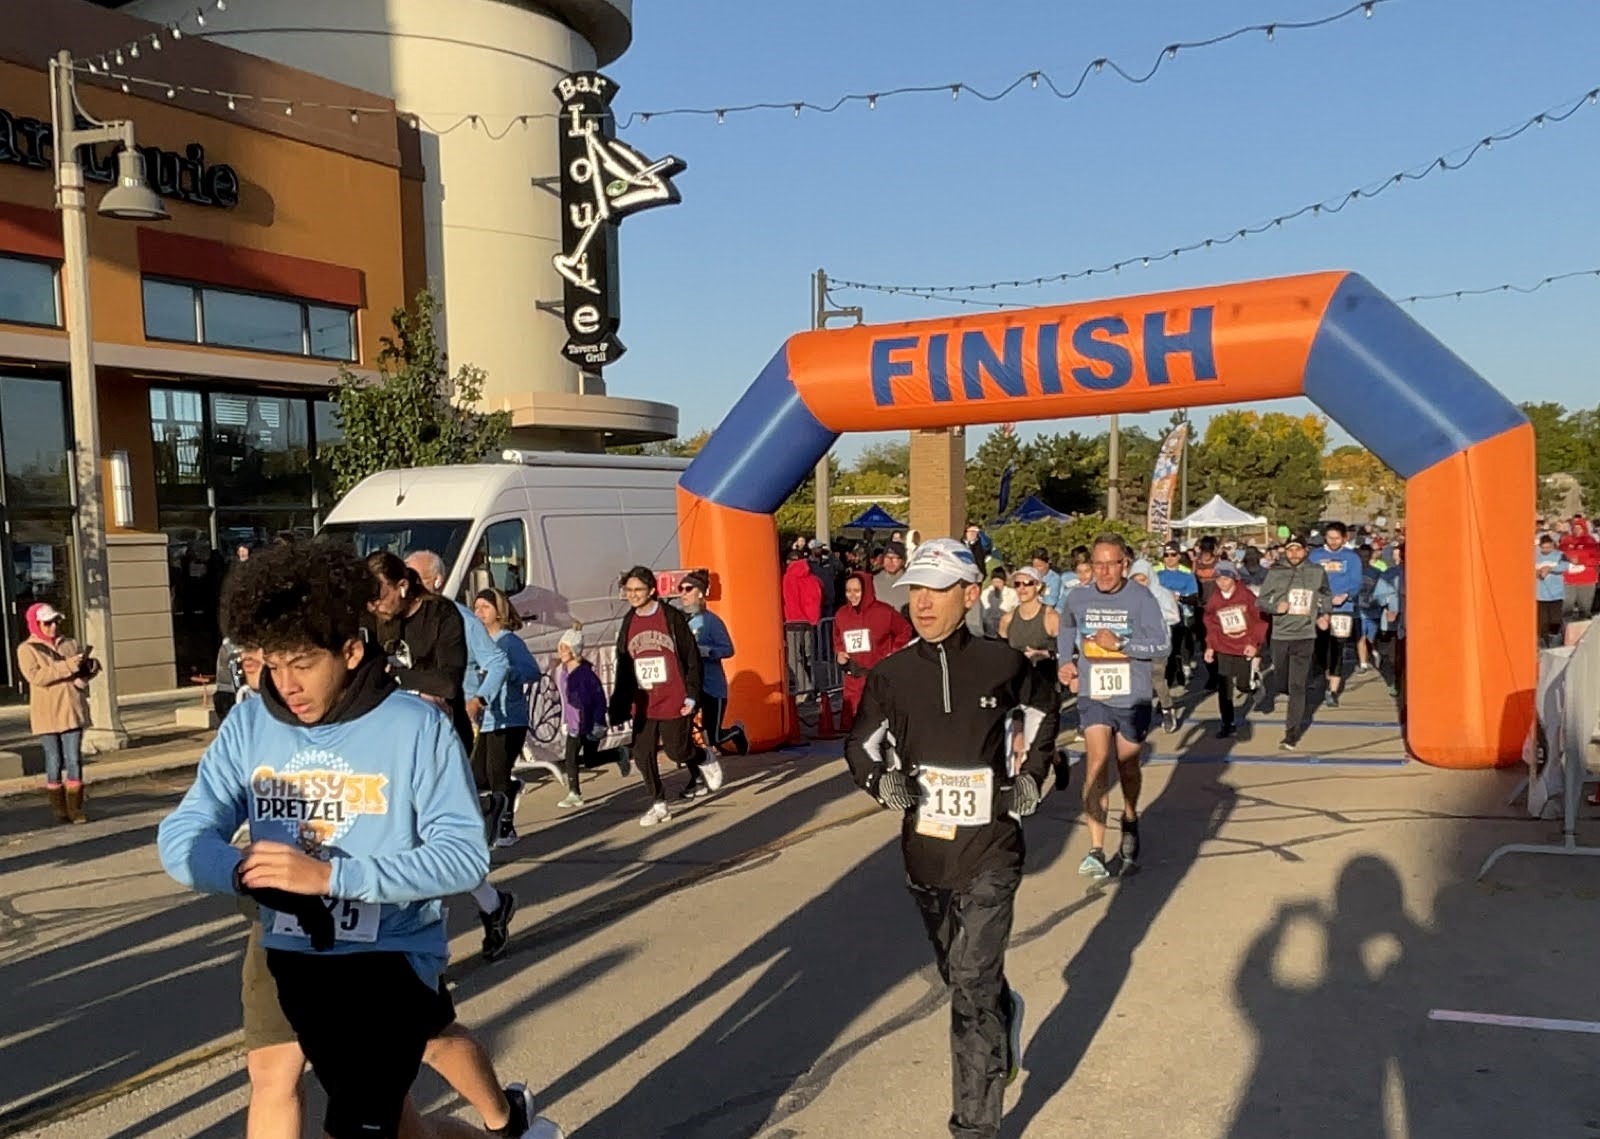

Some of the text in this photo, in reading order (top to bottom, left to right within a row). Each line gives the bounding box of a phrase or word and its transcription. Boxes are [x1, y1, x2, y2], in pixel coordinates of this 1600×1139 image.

[557, 76, 607, 100] Bar
[73, 114, 239, 210] Luie
[567, 344, 598, 355] Tavern
[585, 352, 606, 363] Grill
[871, 305, 1218, 407] FINISH
[851, 637, 862, 650] 25
[1099, 675, 1122, 691] 130
[253, 767, 386, 803] CHEESY 5K
[255, 798, 346, 823] PRETZEL
[935, 788, 977, 818] 133
